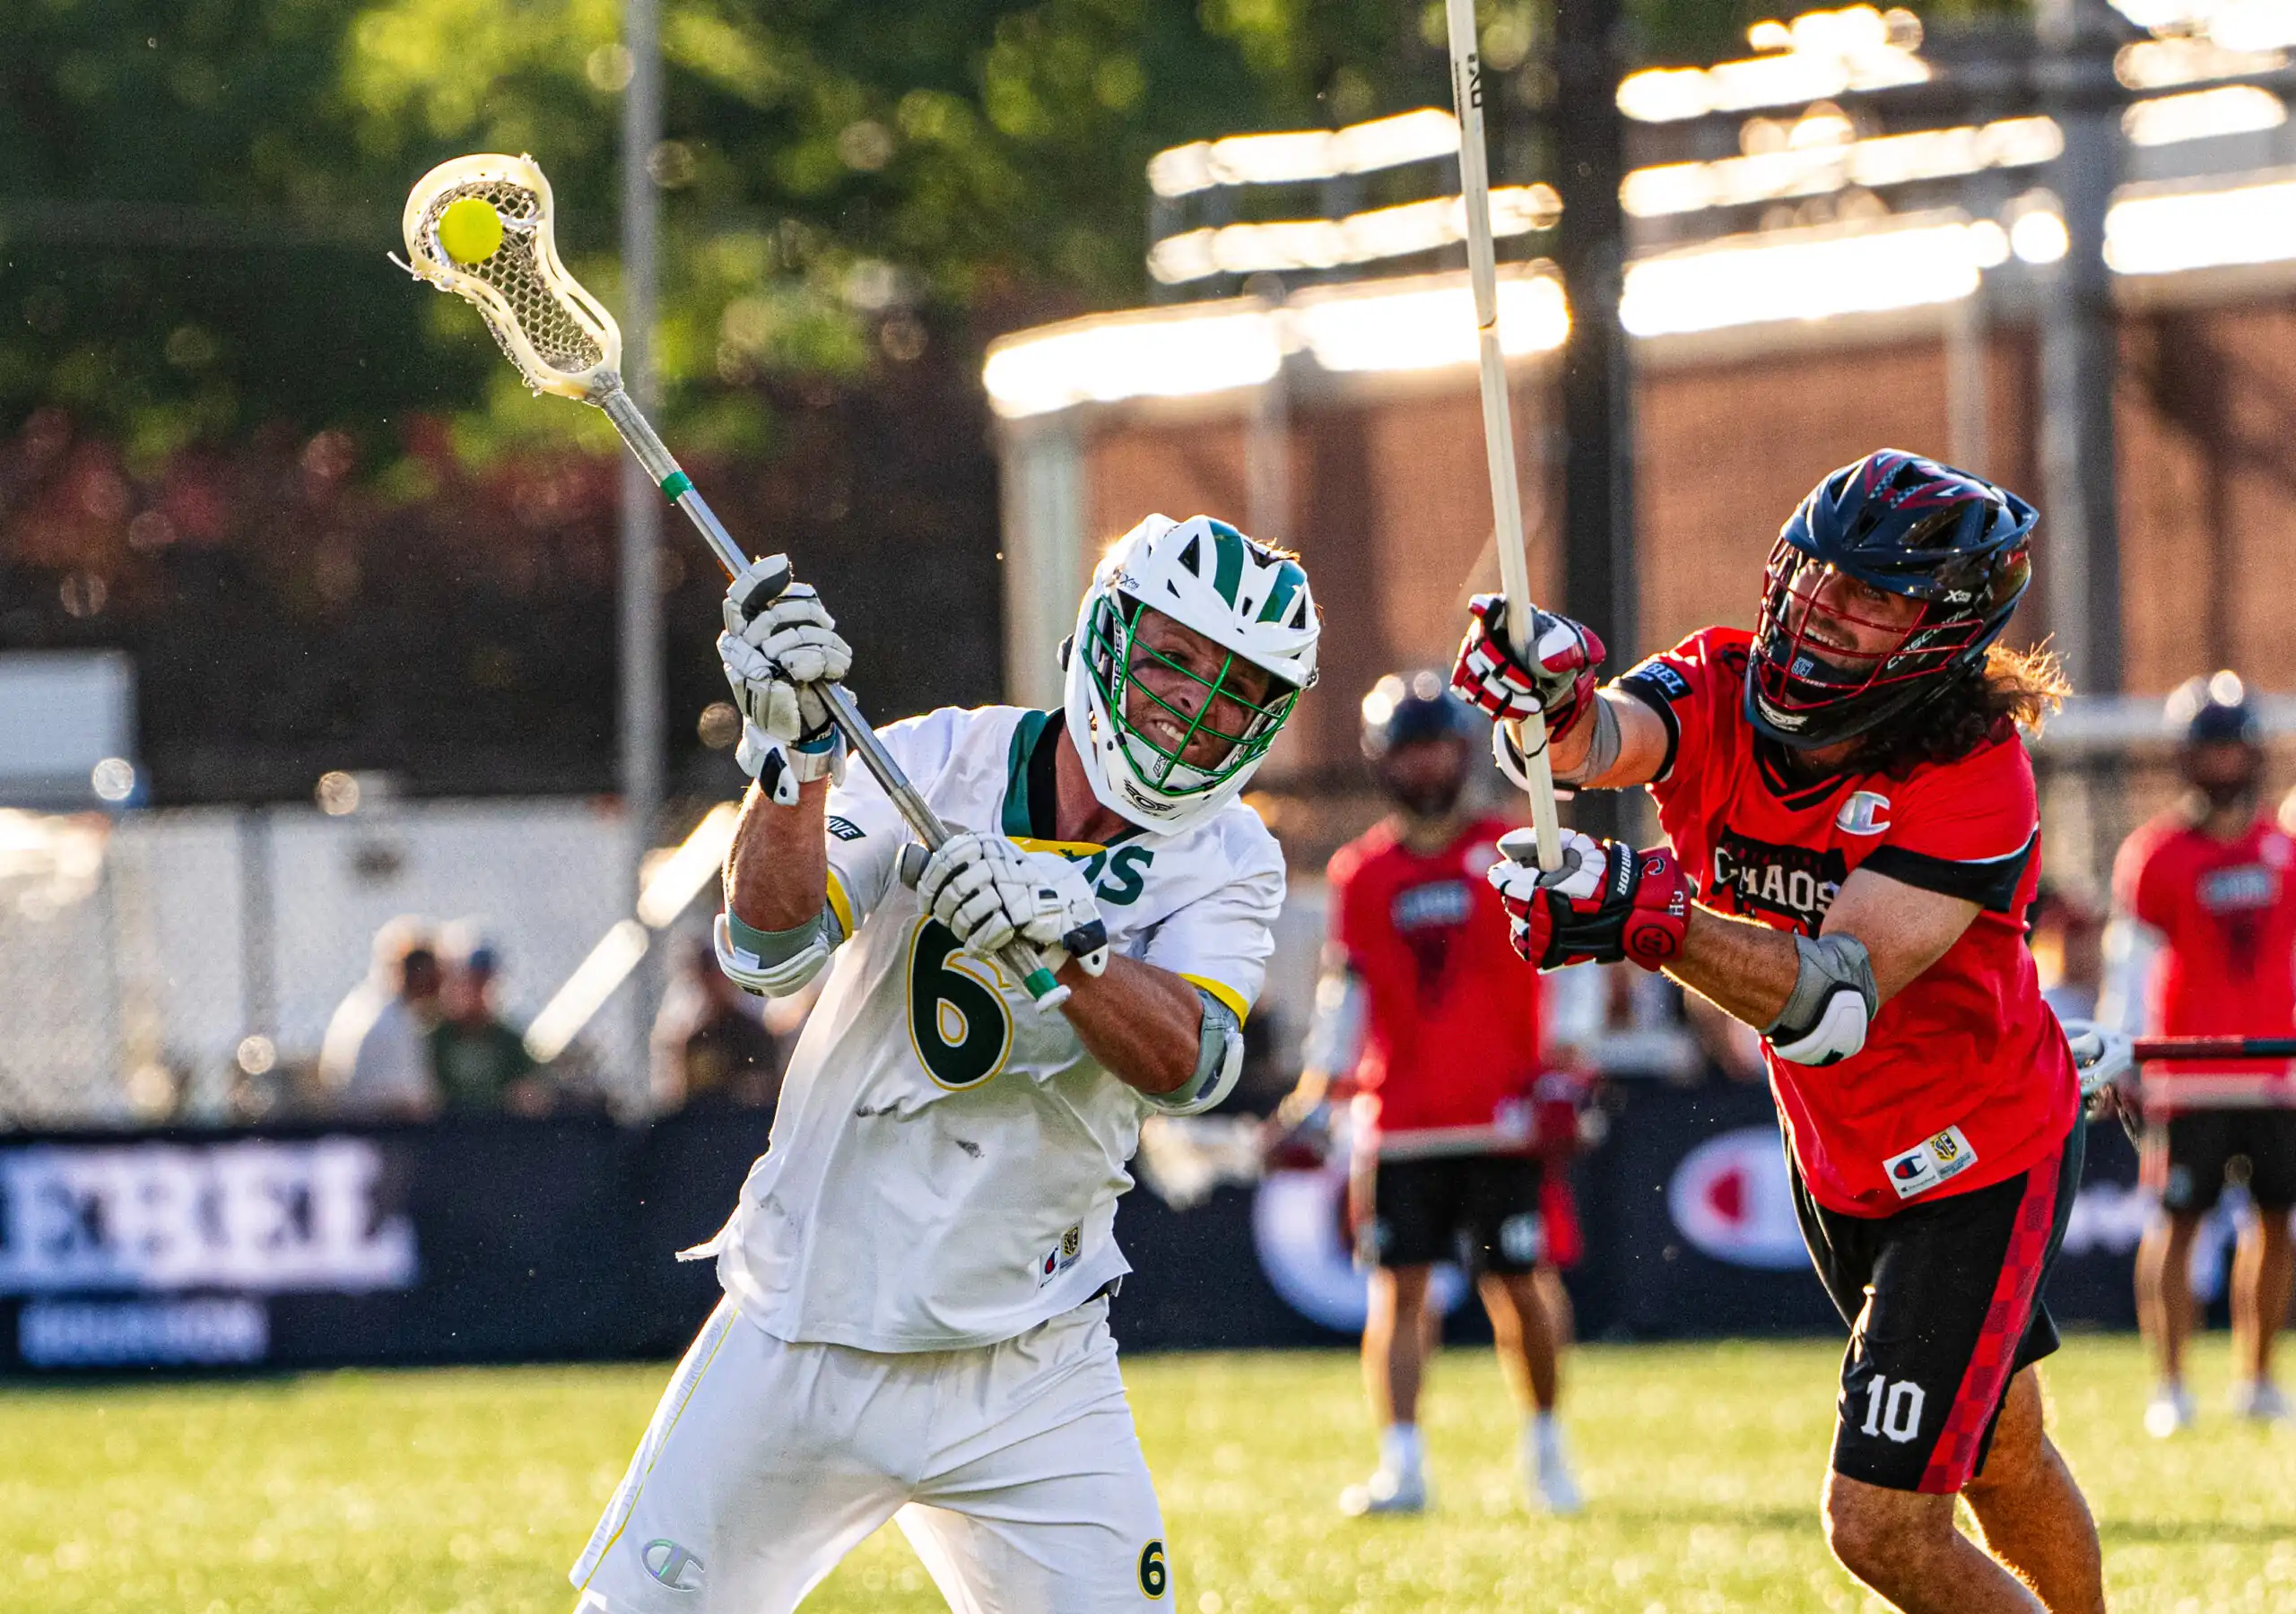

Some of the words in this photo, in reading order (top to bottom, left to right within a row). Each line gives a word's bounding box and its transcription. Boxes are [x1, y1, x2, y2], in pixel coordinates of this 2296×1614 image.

[1617, 842, 1632, 896] RRIOR
[907, 914, 1014, 1092] 6
[0, 1139, 421, 1292] EBEL
[1860, 1373, 1926, 1444] 10
[1136, 1538, 1166, 1601] 6
